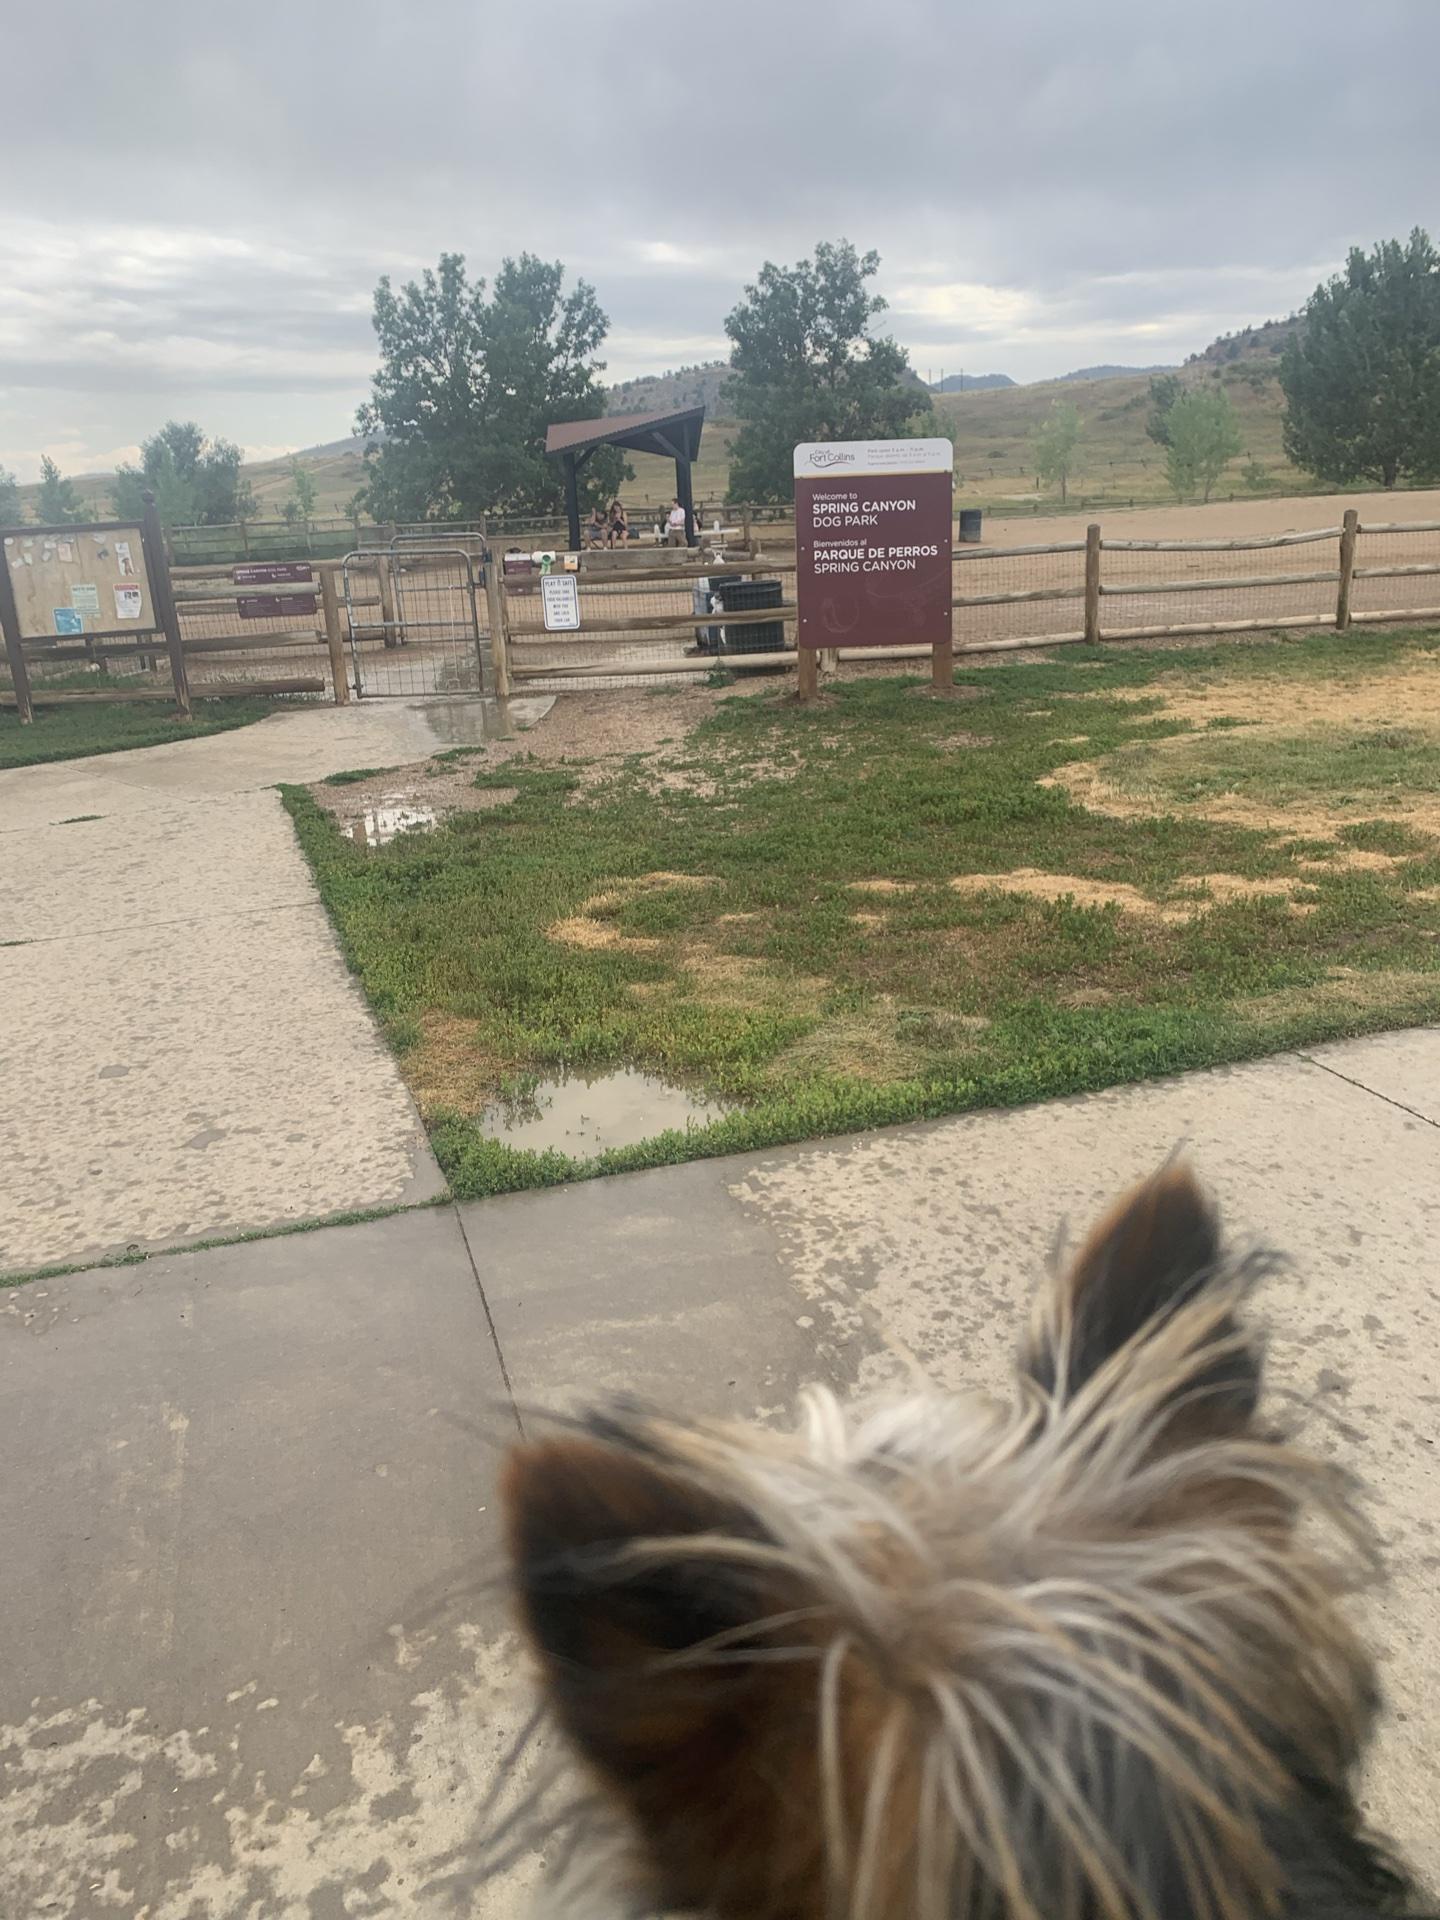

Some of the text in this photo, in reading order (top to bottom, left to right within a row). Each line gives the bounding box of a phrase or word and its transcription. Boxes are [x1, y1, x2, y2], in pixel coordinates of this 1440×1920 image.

[809, 452, 855, 462] Fort Collins
[812, 492, 858, 501] Welcome to
[812, 500, 916, 514] SPRING CANYON
[813, 515, 879, 528] DOG PARK
[813, 538, 867, 548] Bienvenidos al
[814, 545, 938, 561] PARQUE DE PERROS
[814, 560, 916, 574] SPRING CANYON
